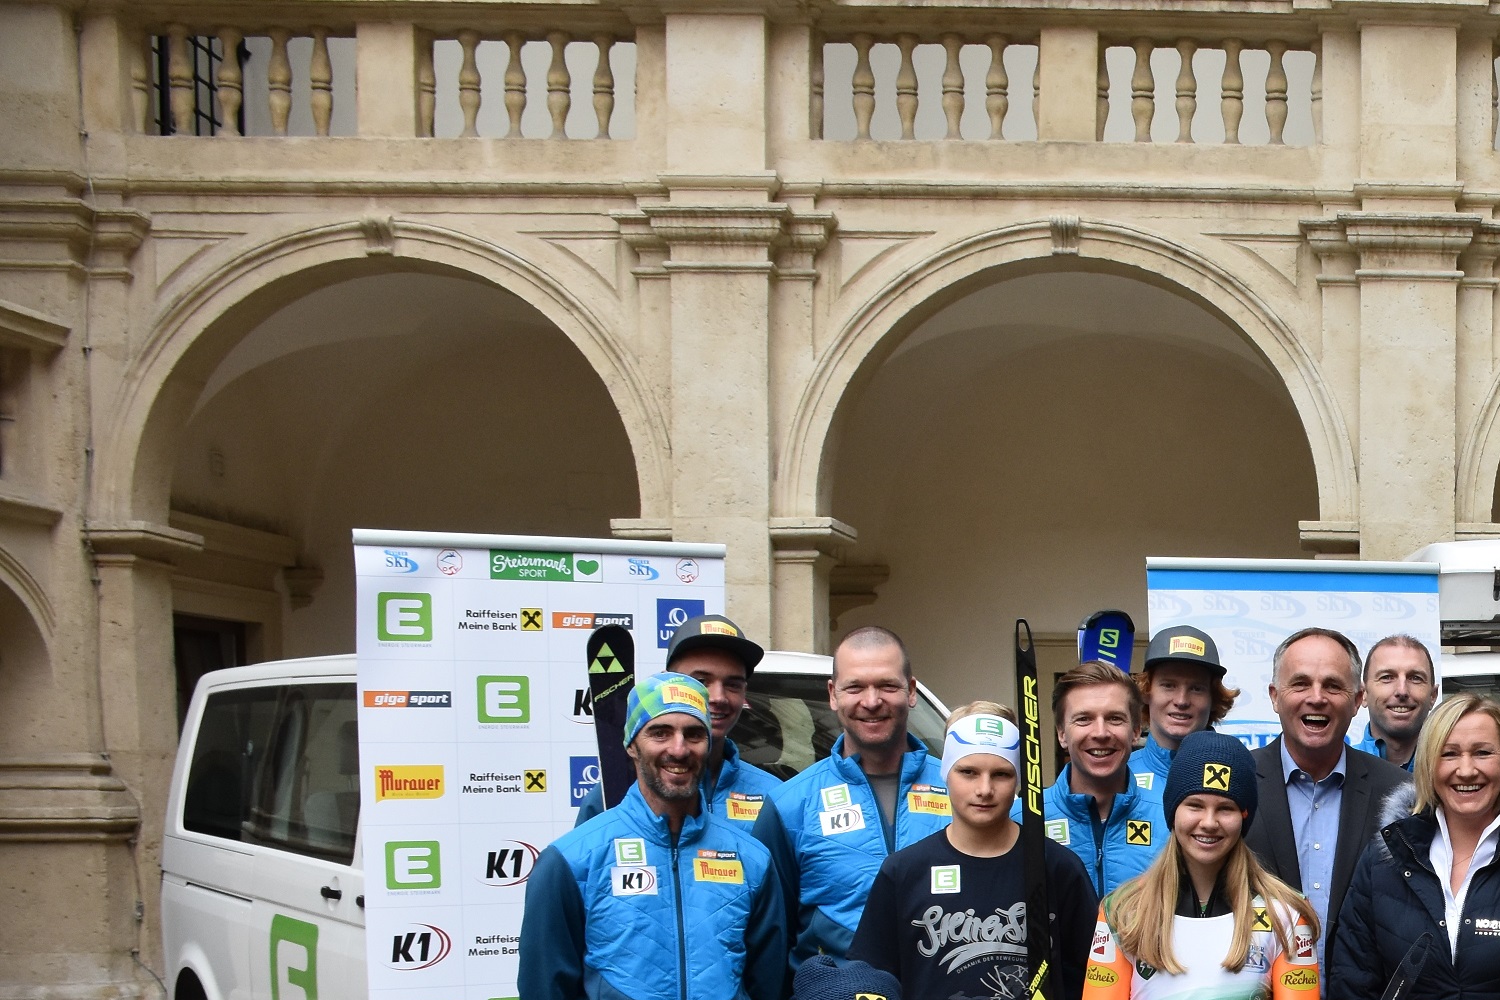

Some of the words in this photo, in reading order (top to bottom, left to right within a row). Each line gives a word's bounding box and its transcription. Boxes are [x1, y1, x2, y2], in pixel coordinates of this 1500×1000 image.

[492, 554, 572, 576] Steiermark
[518, 568, 547, 578] SPORT
[385, 598, 425, 636] E
[465, 609, 518, 619] Raiffeisen
[562, 615, 592, 627] giga
[594, 616, 631, 627] sport
[458, 621, 490, 631] Meine
[492, 622, 518, 631] Bank
[1172, 637, 1203, 653] Murauer
[593, 673, 635, 703] FISCHER
[668, 686, 704, 706] Murauer
[374, 693, 406, 706] giga
[409, 693, 449, 706] sport
[484, 681, 523, 718] E
[1023, 675, 1043, 816] FISCHER
[379, 769, 441, 797] Murauer
[469, 772, 522, 782] Raiffeisen
[462, 785, 494, 795] Meine
[495, 784, 522, 794] Bank
[914, 794, 948, 811] Murauer
[830, 811, 851, 830] K1
[485, 848, 524, 879] K1
[717, 852, 736, 860] sport
[393, 847, 433, 884] E
[699, 860, 738, 878] Murauer
[622, 872, 644, 890] K1
[390, 931, 432, 964] K1
[475, 933, 521, 945] Raiffeise
[468, 947, 498, 957] Meine
[500, 946, 520, 956] Ban
[956, 959, 982, 975] DYNAMIK
